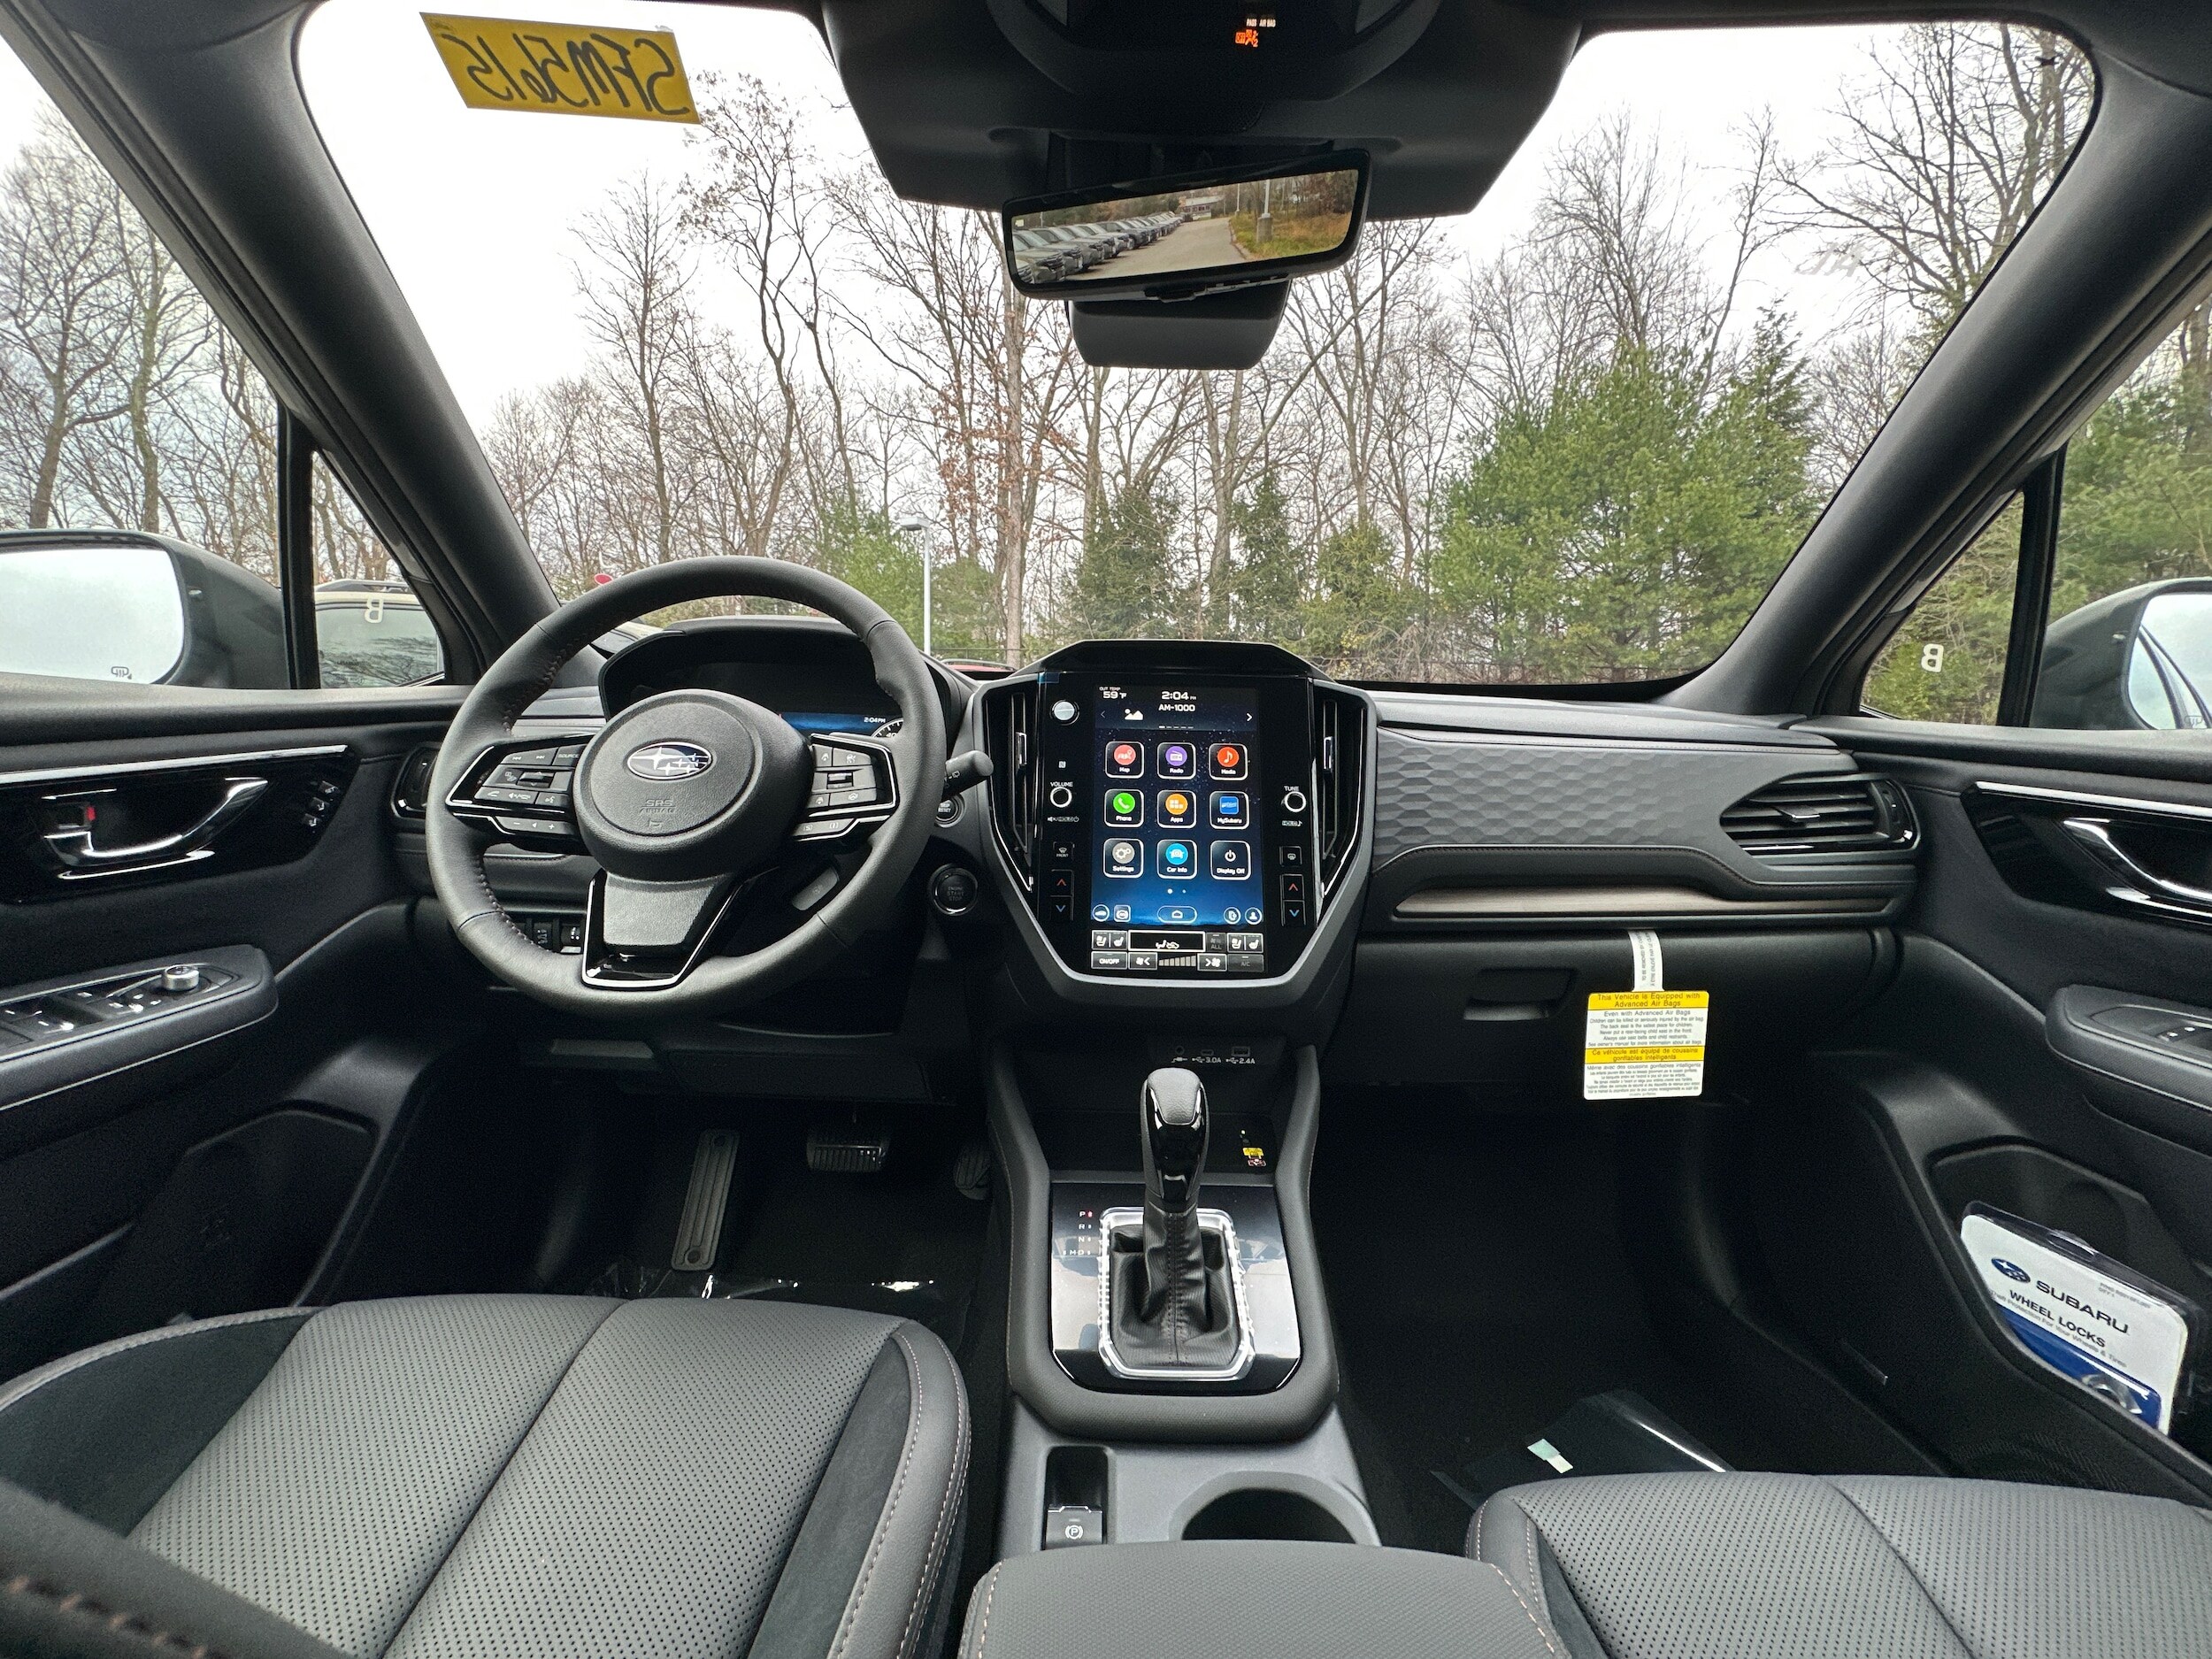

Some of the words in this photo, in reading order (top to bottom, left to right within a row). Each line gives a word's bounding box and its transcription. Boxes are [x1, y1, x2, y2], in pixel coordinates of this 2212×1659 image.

[1161, 691, 1189, 700] 2:04
[1158, 703, 1196, 712] AM-1000
[645, 798, 673, 806] SRS
[2036, 1280, 2129, 1334] SUBARU
[2009, 1290, 2055, 1321] WHEEL
[2058, 1316, 2106, 1348] LOCKS
